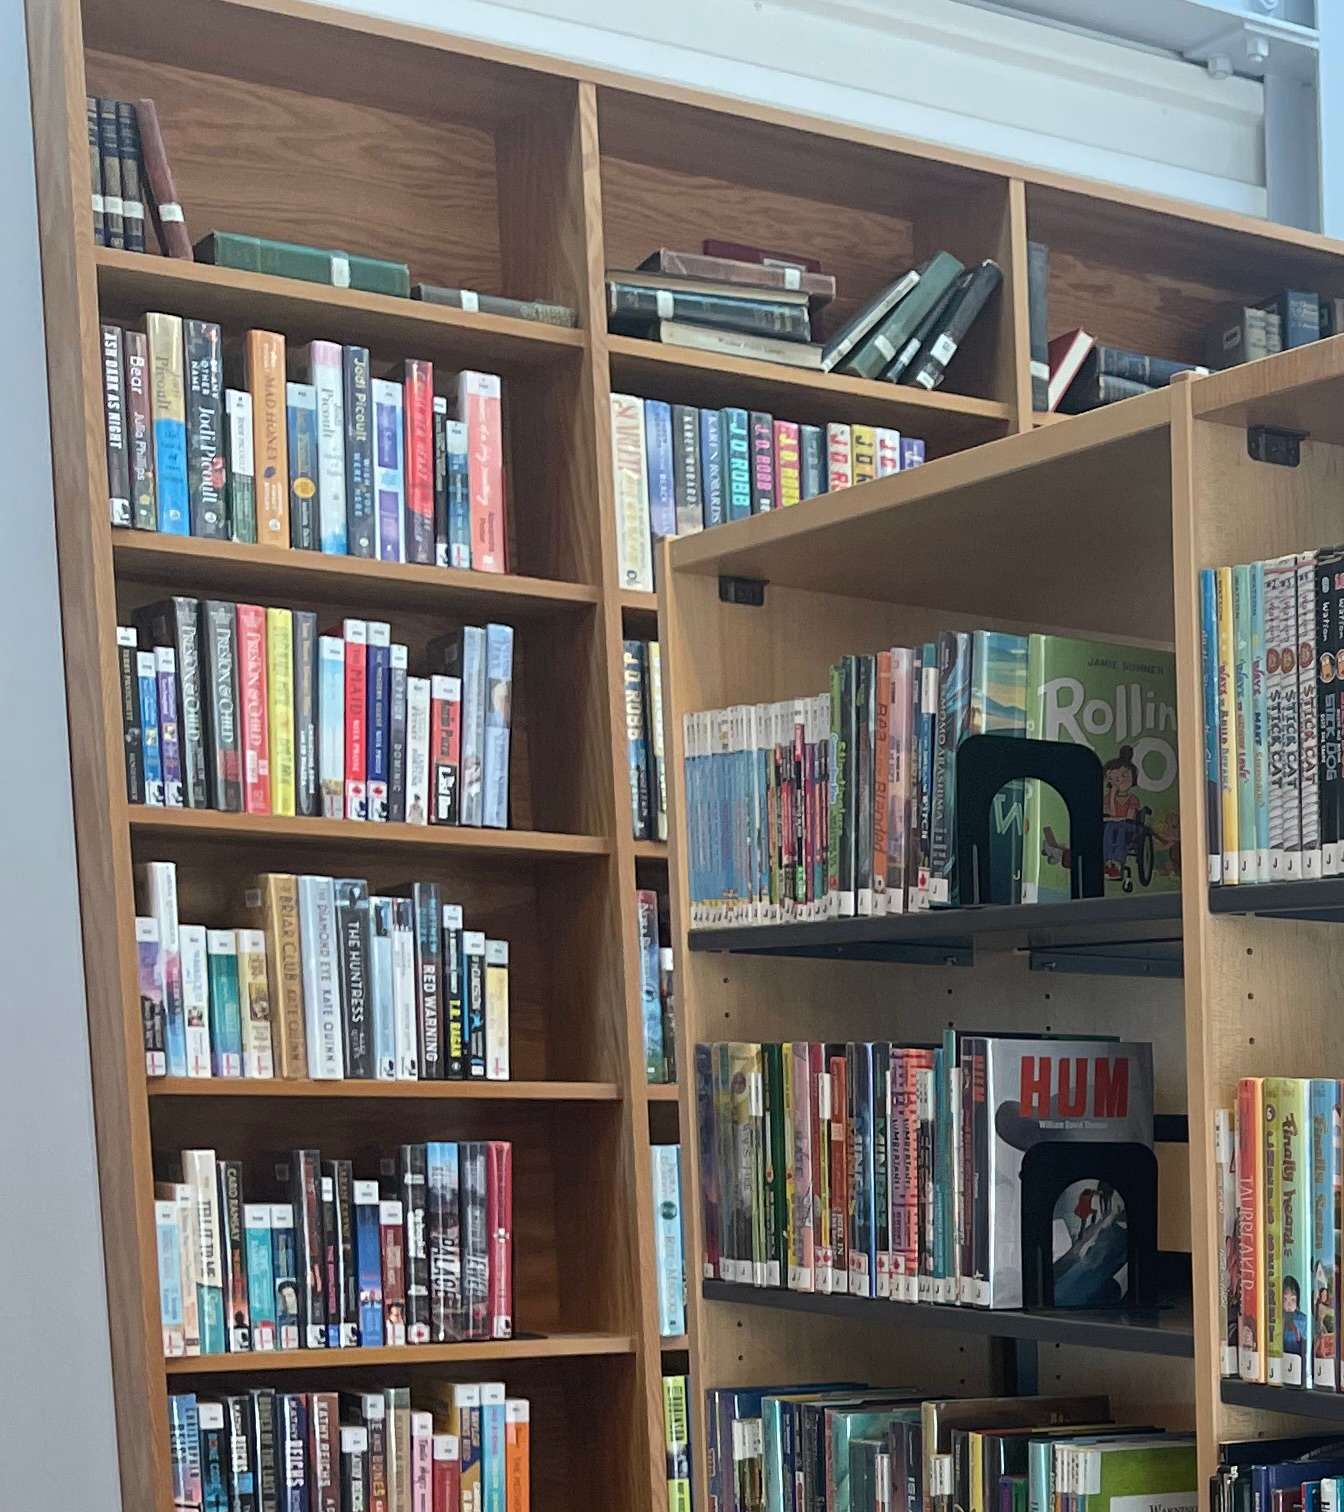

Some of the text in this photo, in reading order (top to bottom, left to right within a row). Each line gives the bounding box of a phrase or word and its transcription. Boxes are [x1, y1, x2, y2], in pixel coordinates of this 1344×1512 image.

[130, 356, 144, 394] Bear
[192, 361, 200, 391] NAME
[108, 412, 122, 449] NIGHT
[355, 390, 368, 442] Picoult
[199, 406, 218, 503] Jodi Picoult
[755, 455, 772, 492] ROBB
[730, 456, 750, 507] ROBB
[1303, 748, 1316, 786] CAT
[1325, 740, 1337, 781] DOG
[346, 920, 364, 1024] THE HUNTRESS
[422, 963, 439, 1064] RED WARNING
[1019, 1056, 1129, 1118] HUM
